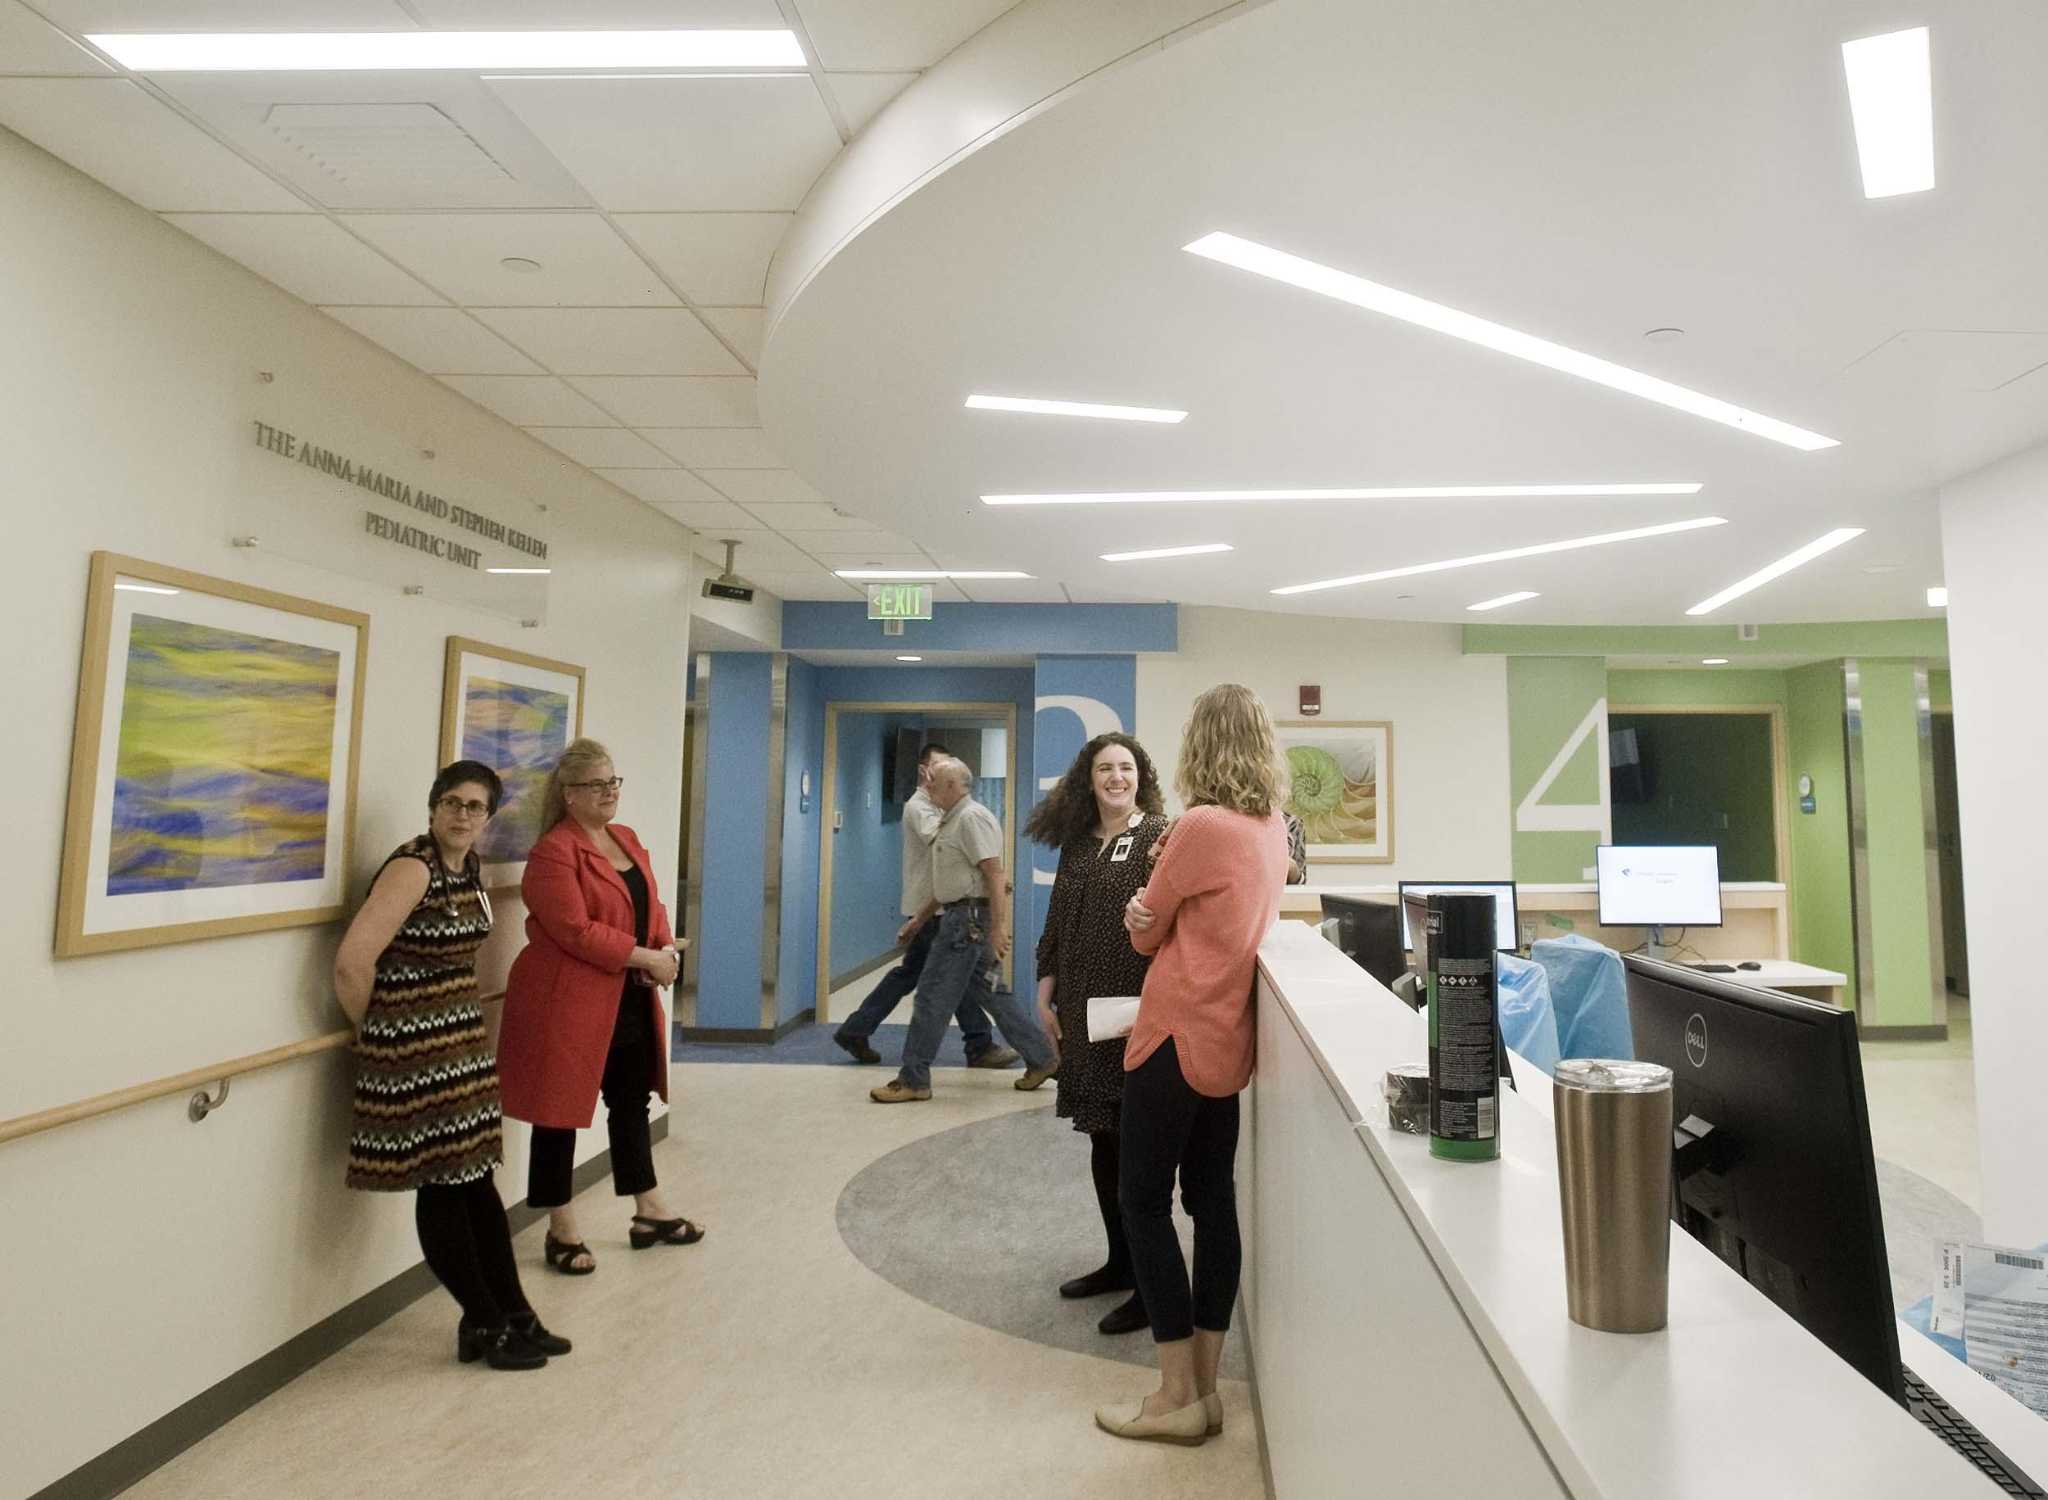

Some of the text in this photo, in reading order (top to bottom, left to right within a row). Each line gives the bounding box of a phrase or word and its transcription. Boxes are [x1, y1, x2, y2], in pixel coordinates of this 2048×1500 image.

[254, 420, 548, 560] THE ANNA-MARIA AND STEPHEN KELLEN
[365, 511, 482, 570] PEDIATRIC UNIT
[881, 586, 923, 616] EXIT
[1515, 697, 1613, 880] 4
[1687, 1031, 1705, 1050] DELL
